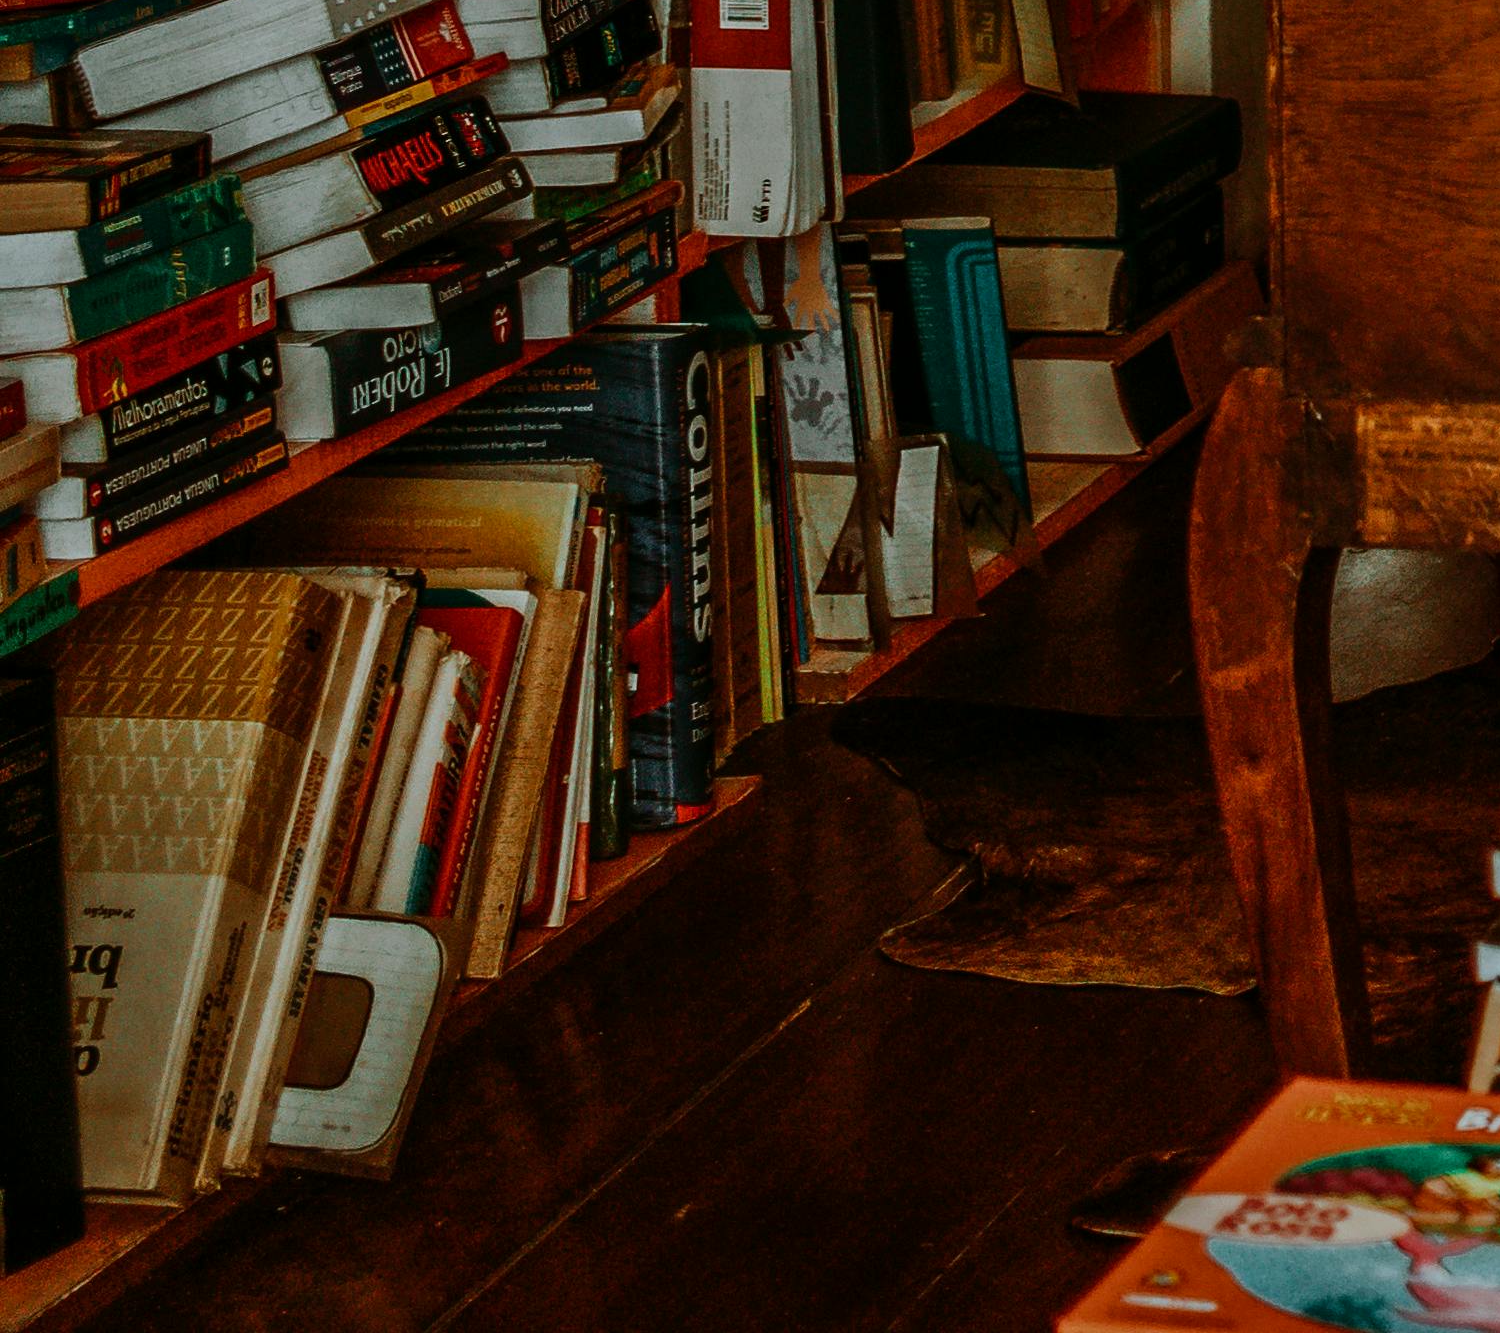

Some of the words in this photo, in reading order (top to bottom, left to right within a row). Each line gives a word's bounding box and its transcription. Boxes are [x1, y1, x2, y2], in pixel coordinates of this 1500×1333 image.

[359, 130, 445, 193] MICHAELIS
[110, 375, 210, 434] Melhoramentos
[175, 437, 209, 465] LÍNGUA
[104, 453, 172, 496] PORTUGUESA
[186, 472, 221, 505] LÍNGUA
[686, 347, 712, 644] Collins
[115, 493, 183, 533] PORTUGUESA
